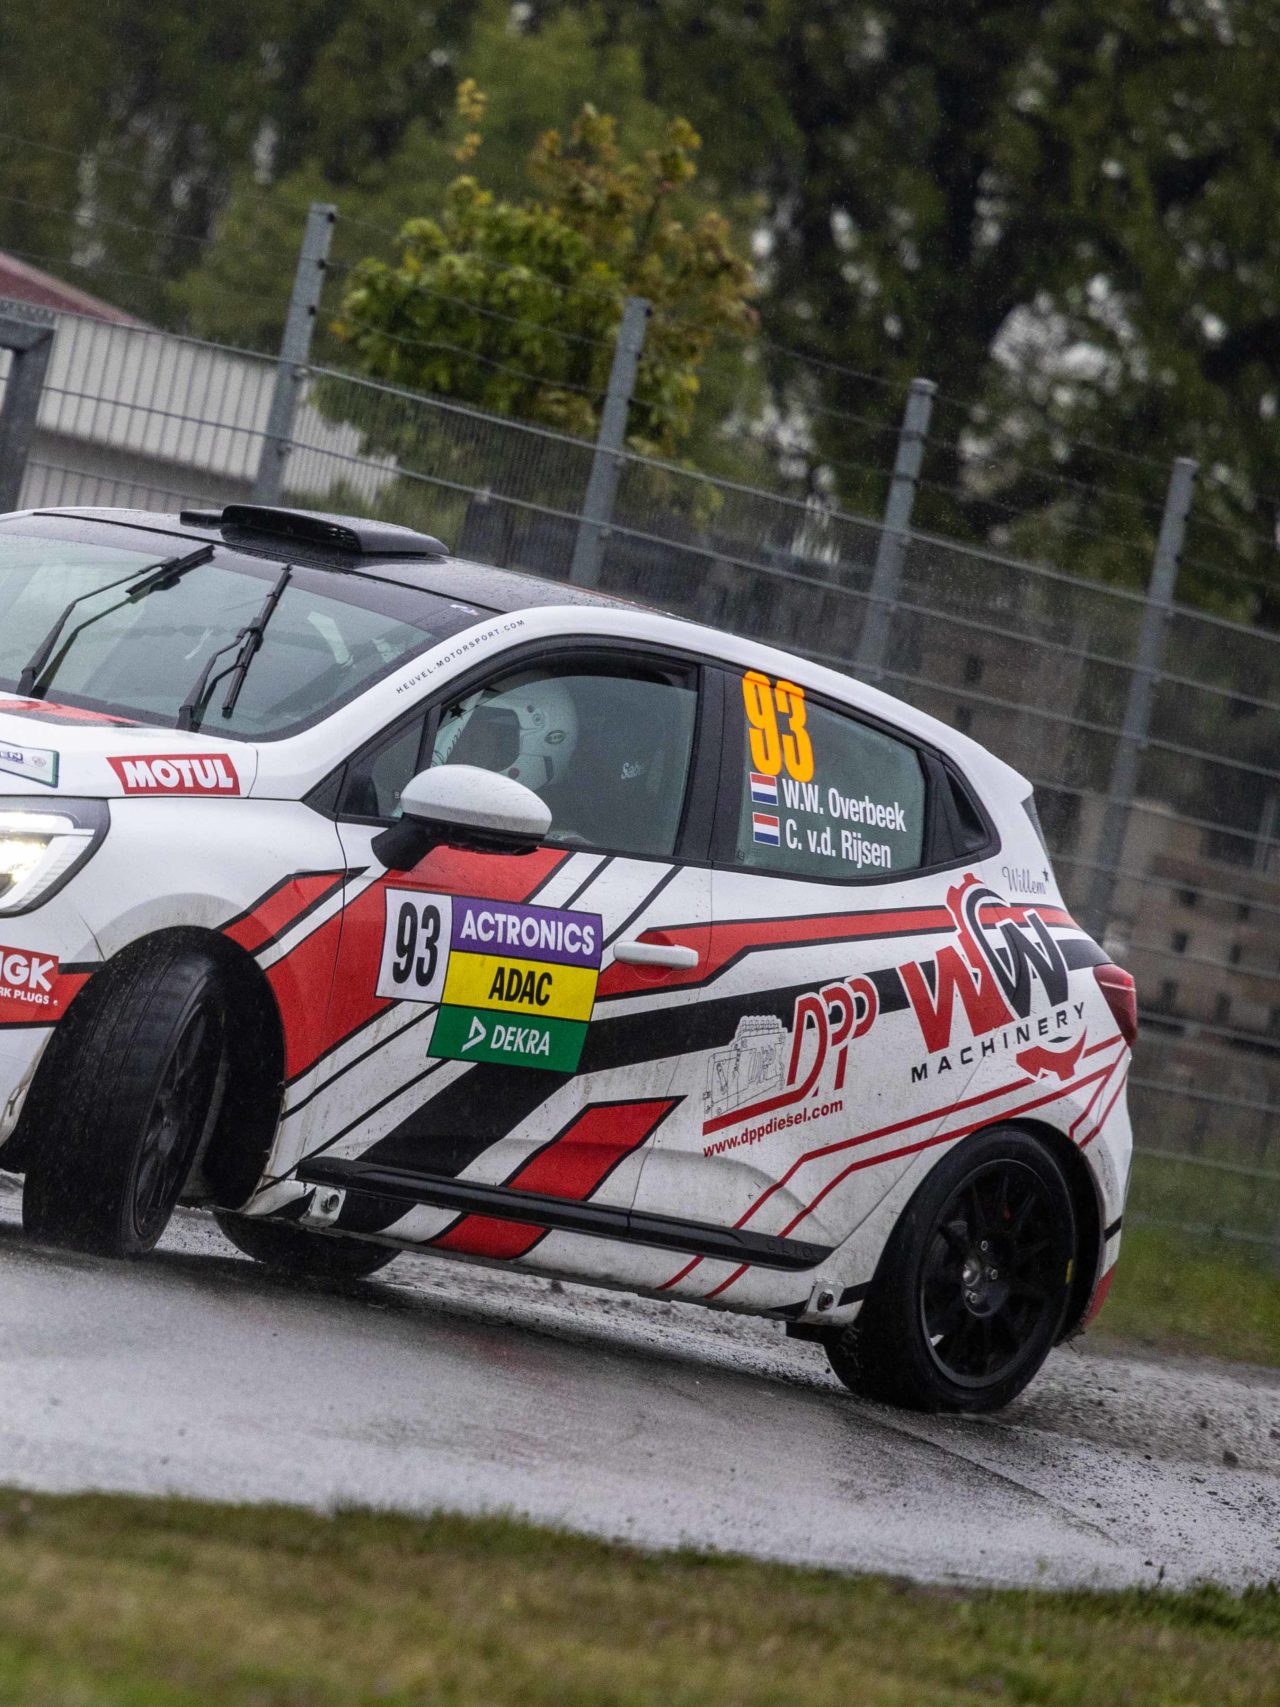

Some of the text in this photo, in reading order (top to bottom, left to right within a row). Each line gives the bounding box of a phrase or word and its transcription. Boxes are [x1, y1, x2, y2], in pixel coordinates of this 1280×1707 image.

[396, 619, 525, 694] HEUVEL-MOTORSPORT.COM
[742, 670, 814, 782] 93
[121, 759, 234, 789] MOTUL
[782, 778, 907, 832] W.W. Overbeek
[785, 819, 892, 869] C. v.d. Rijsen
[1002, 866, 1046, 895] Willem
[392, 901, 441, 987] 93
[460, 910, 595, 955] ACTRONICS
[13, 989, 50, 1005] PLUGS
[488, 966, 553, 1007] ADAC
[490, 1024, 550, 1056] DEKRA
[911, 1002, 1085, 1083] MACHINERY
[703, 1100, 843, 1159] www.dppdiesel.com
